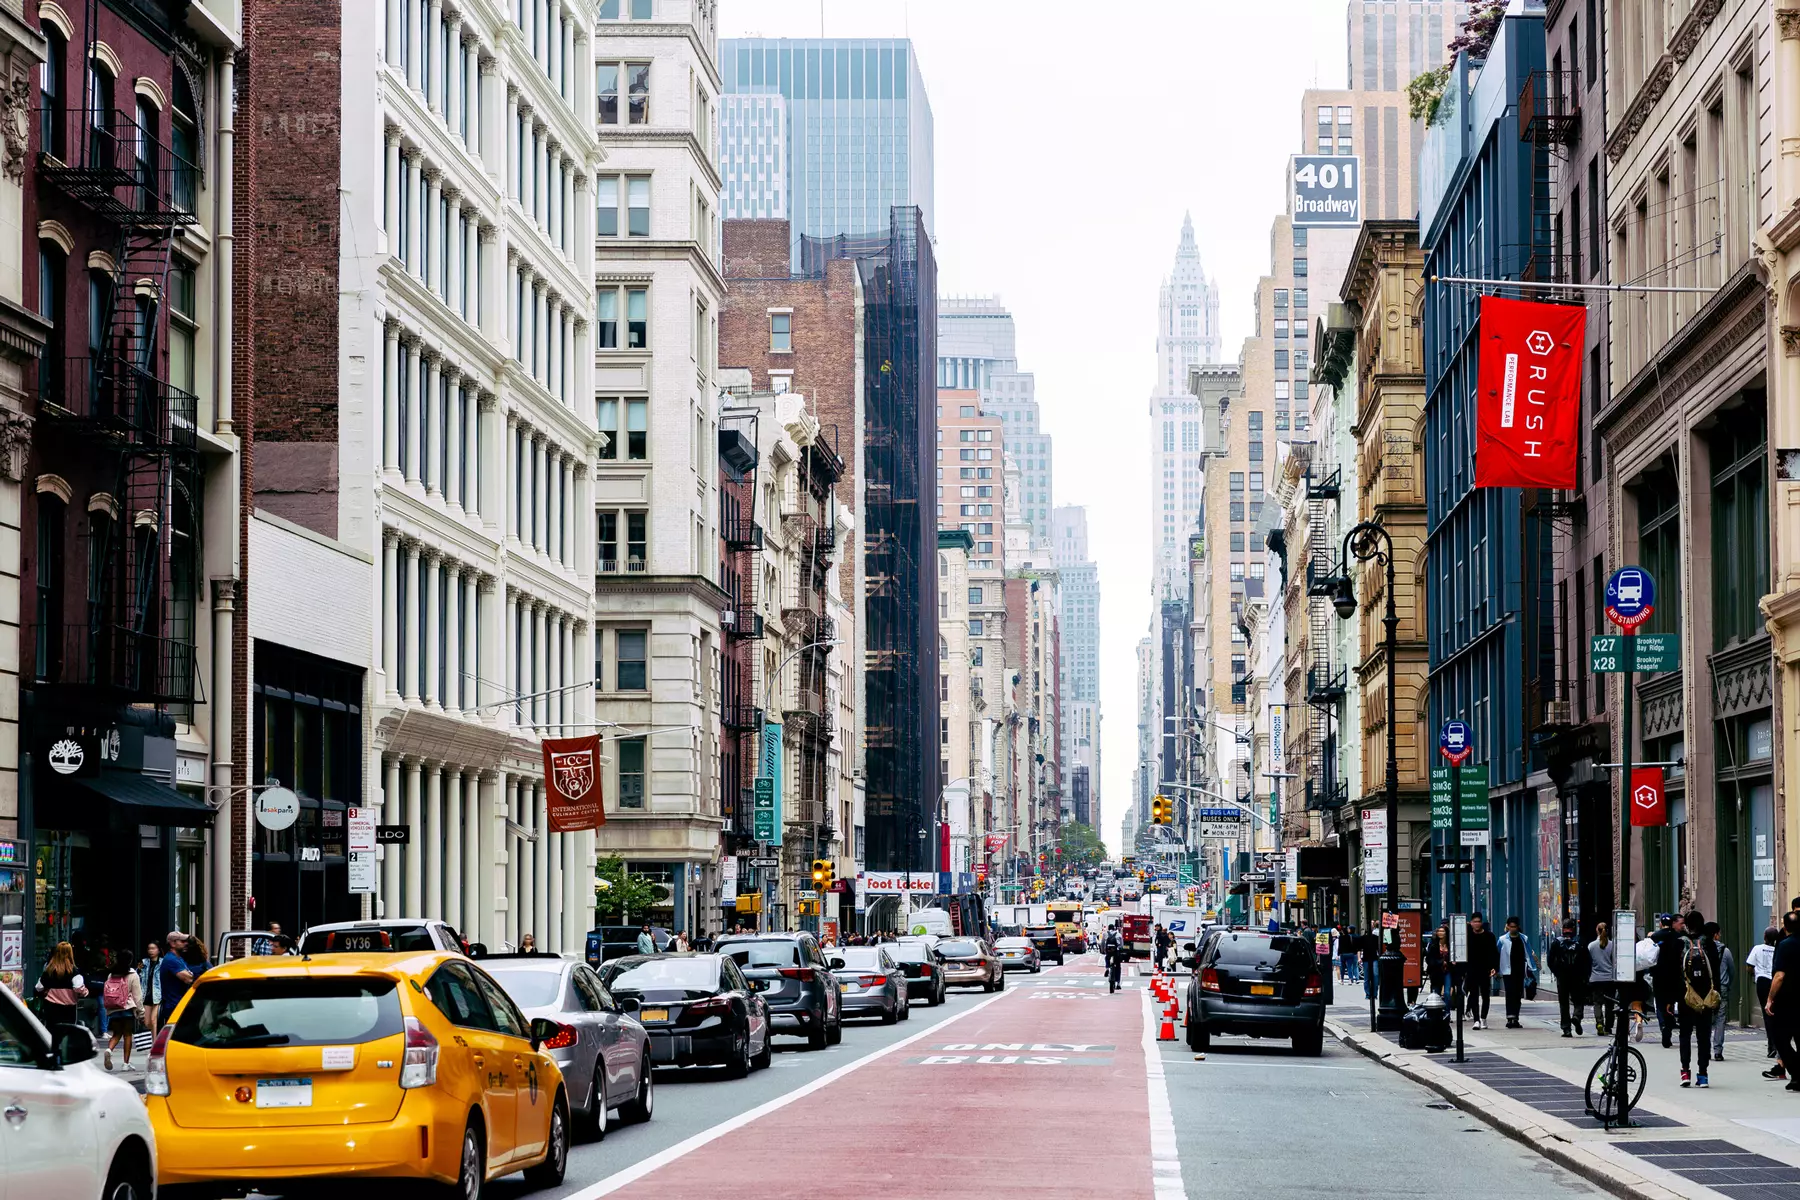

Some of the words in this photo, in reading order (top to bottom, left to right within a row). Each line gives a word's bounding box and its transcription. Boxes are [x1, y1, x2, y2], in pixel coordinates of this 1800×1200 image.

[1296, 163, 1352, 188] 401
[1296, 194, 1357, 218] Broadway
[1506, 356, 1515, 406] PERFORMANCE
[1524, 365, 1547, 457] RUSH
[1608, 608, 1618, 619] NO
[1618, 607, 1650, 624] STANDING
[765, 727, 778, 777] Mystique
[1448, 748, 1470, 759] STANDING
[563, 756, 582, 766] ICC
[1433, 769, 1447, 778] SIM1
[1433, 781, 1452, 790] SIM3c
[1433, 793, 1451, 802] SIM4c
[552, 803, 598, 812] INTERNATIONAL
[1433, 806, 1452, 815] SIM33c
[350, 809, 356, 818] 3
[1433, 818, 1452, 828] SIM34
[867, 878, 892, 889] Foot
[346, 937, 370, 950] 9Y36
[942, 1044, 1096, 1052] ONLY
[920, 1055, 1068, 1065] BUS
